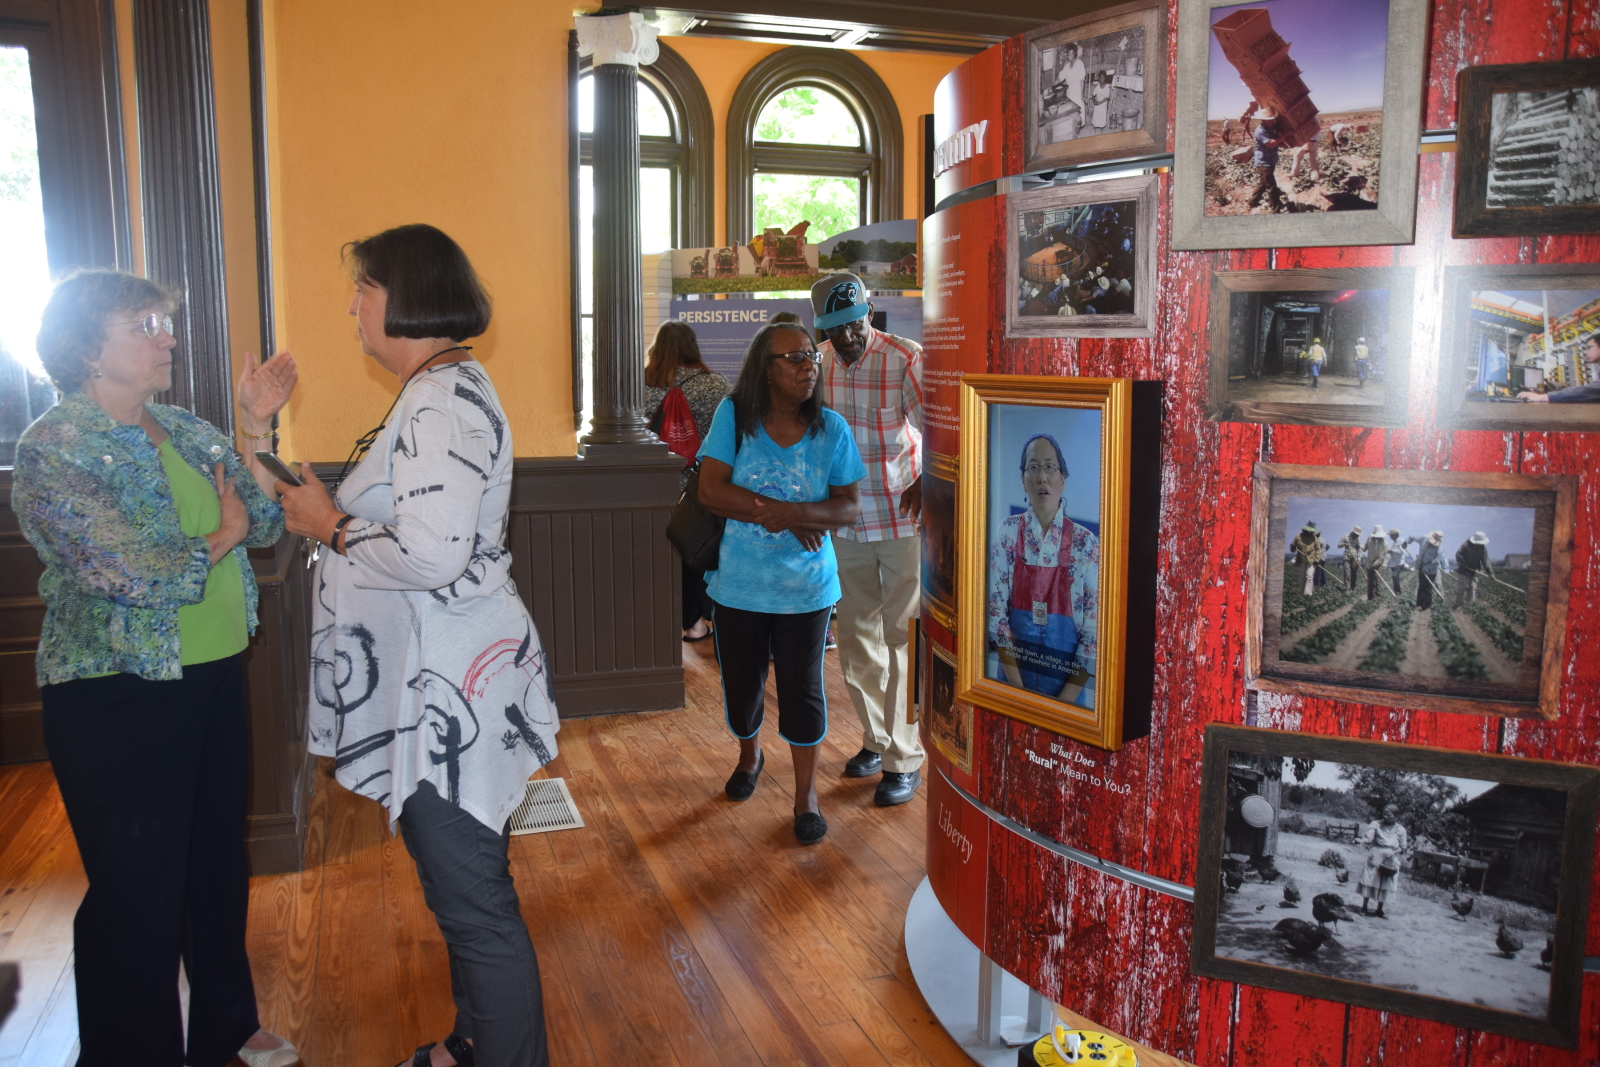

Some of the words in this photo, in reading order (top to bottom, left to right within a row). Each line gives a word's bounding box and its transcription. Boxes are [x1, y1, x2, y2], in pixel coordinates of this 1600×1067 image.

[933, 120, 988, 179] DENTITY
[678, 310, 767, 323] PERSISTENCE
[1005, 650, 1021, 660] middle
[1029, 658, 1050, 668] nowhere
[1058, 665, 1081, 676] America.
[1025, 648, 1038, 658] town,
[1045, 655, 1063, 665] village,
[1050, 742, 1072, 760] What
[1074, 752, 1095, 768] Does
[1060, 762, 1088, 782] Mean
[1090, 775, 1101, 786] to
[1104, 777, 1131, 795] You?
[938, 802, 973, 864] Liberty
